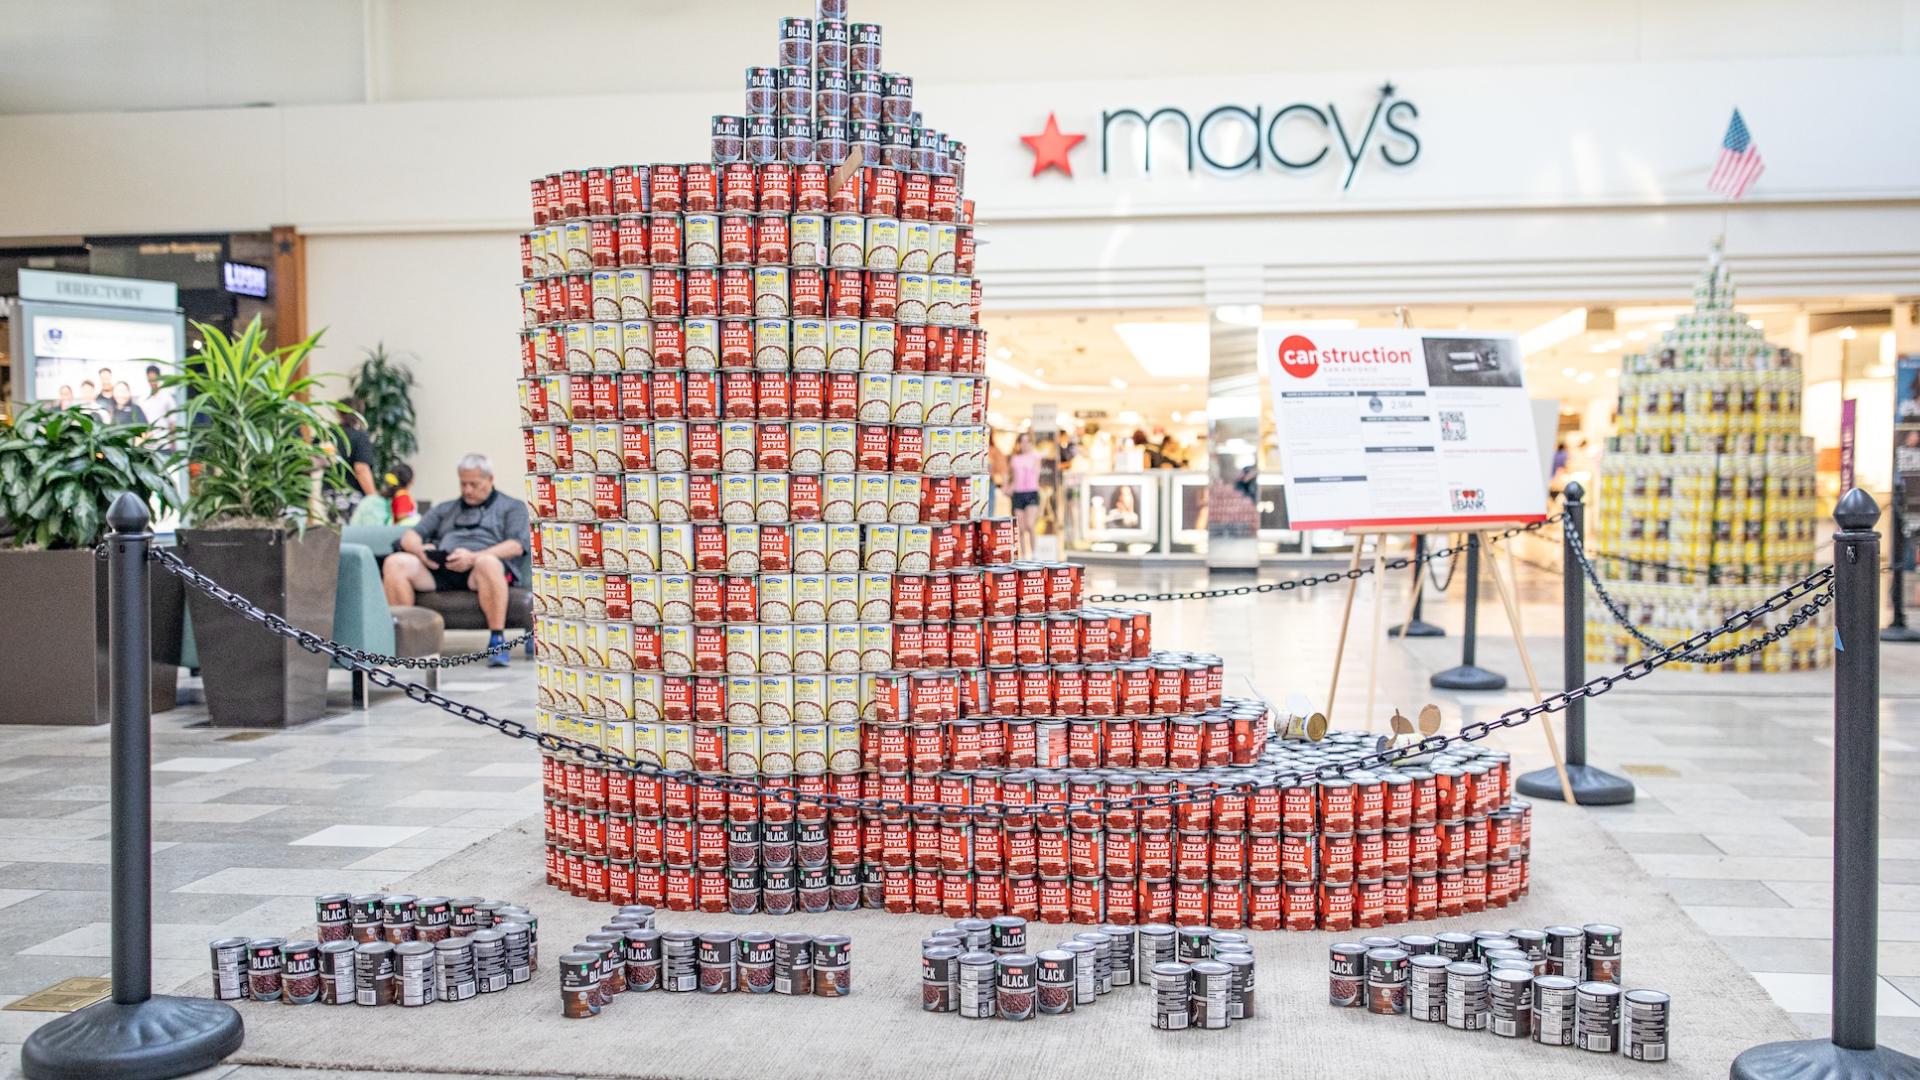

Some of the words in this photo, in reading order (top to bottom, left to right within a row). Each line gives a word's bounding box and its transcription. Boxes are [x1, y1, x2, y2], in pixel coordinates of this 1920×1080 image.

[788, 27, 810, 38] BLACK
[826, 30, 846, 40] BLACK
[860, 32, 881, 43] BLACK
[753, 76, 774, 86] BLACK
[789, 76, 810, 86] BLACK
[826, 78, 846, 89] BLACK
[862, 81, 881, 93] BLACK
[891, 85, 912, 96] BLACK
[717, 124, 739, 134] BLACK
[753, 124, 774, 134] BLACK
[789, 124, 810, 136] BLACK
[823, 127, 844, 138] BLACK
[860, 130, 879, 140] BLACK
[763, 173, 788, 181] TEXAS
[801, 173, 825, 181] TEXAS
[687, 182, 709, 190] STYLE
[728, 181, 752, 189] STYLE
[723, 226, 747, 234] TEXAS
[653, 279, 675, 287] TEXAS
[688, 279, 711, 287] TEXAS
[795, 279, 819, 287] TEXAS
[56, 279, 143, 302] DIRECTORY
[1283, 346, 1412, 366] canstruction
[793, 484, 817, 492] TEXAS
[1142, 739, 1166, 747] STYLE
[917, 745, 939, 753] STYLE
[767, 832, 788, 841] BLACK
[803, 831, 824, 841] BLACK
[1011, 839, 1035, 848] TEXAS
[1039, 840, 1062, 848] TEXAS
[1216, 843, 1240, 851] TEXAS
[1012, 847, 1035, 855] STYLE
[1183, 851, 1206, 859] STYLE
[1253, 853, 1278, 861] STYLE
[733, 879, 754, 889] BLACK
[768, 879, 789, 889] BLACK
[806, 877, 827, 887] BLACK
[835, 875, 856, 885] BLACK
[1214, 893, 1238, 901] TEXAS
[322, 910, 347, 920] BLACK
[1003, 934, 1025, 946] BLACK
[628, 948, 652, 960] BLACK
[750, 950, 774, 962] BLACK
[288, 960, 315, 972] BLACK
[1039, 968, 1065, 981] BLACK
[1002, 975, 1028, 987] BLACK
